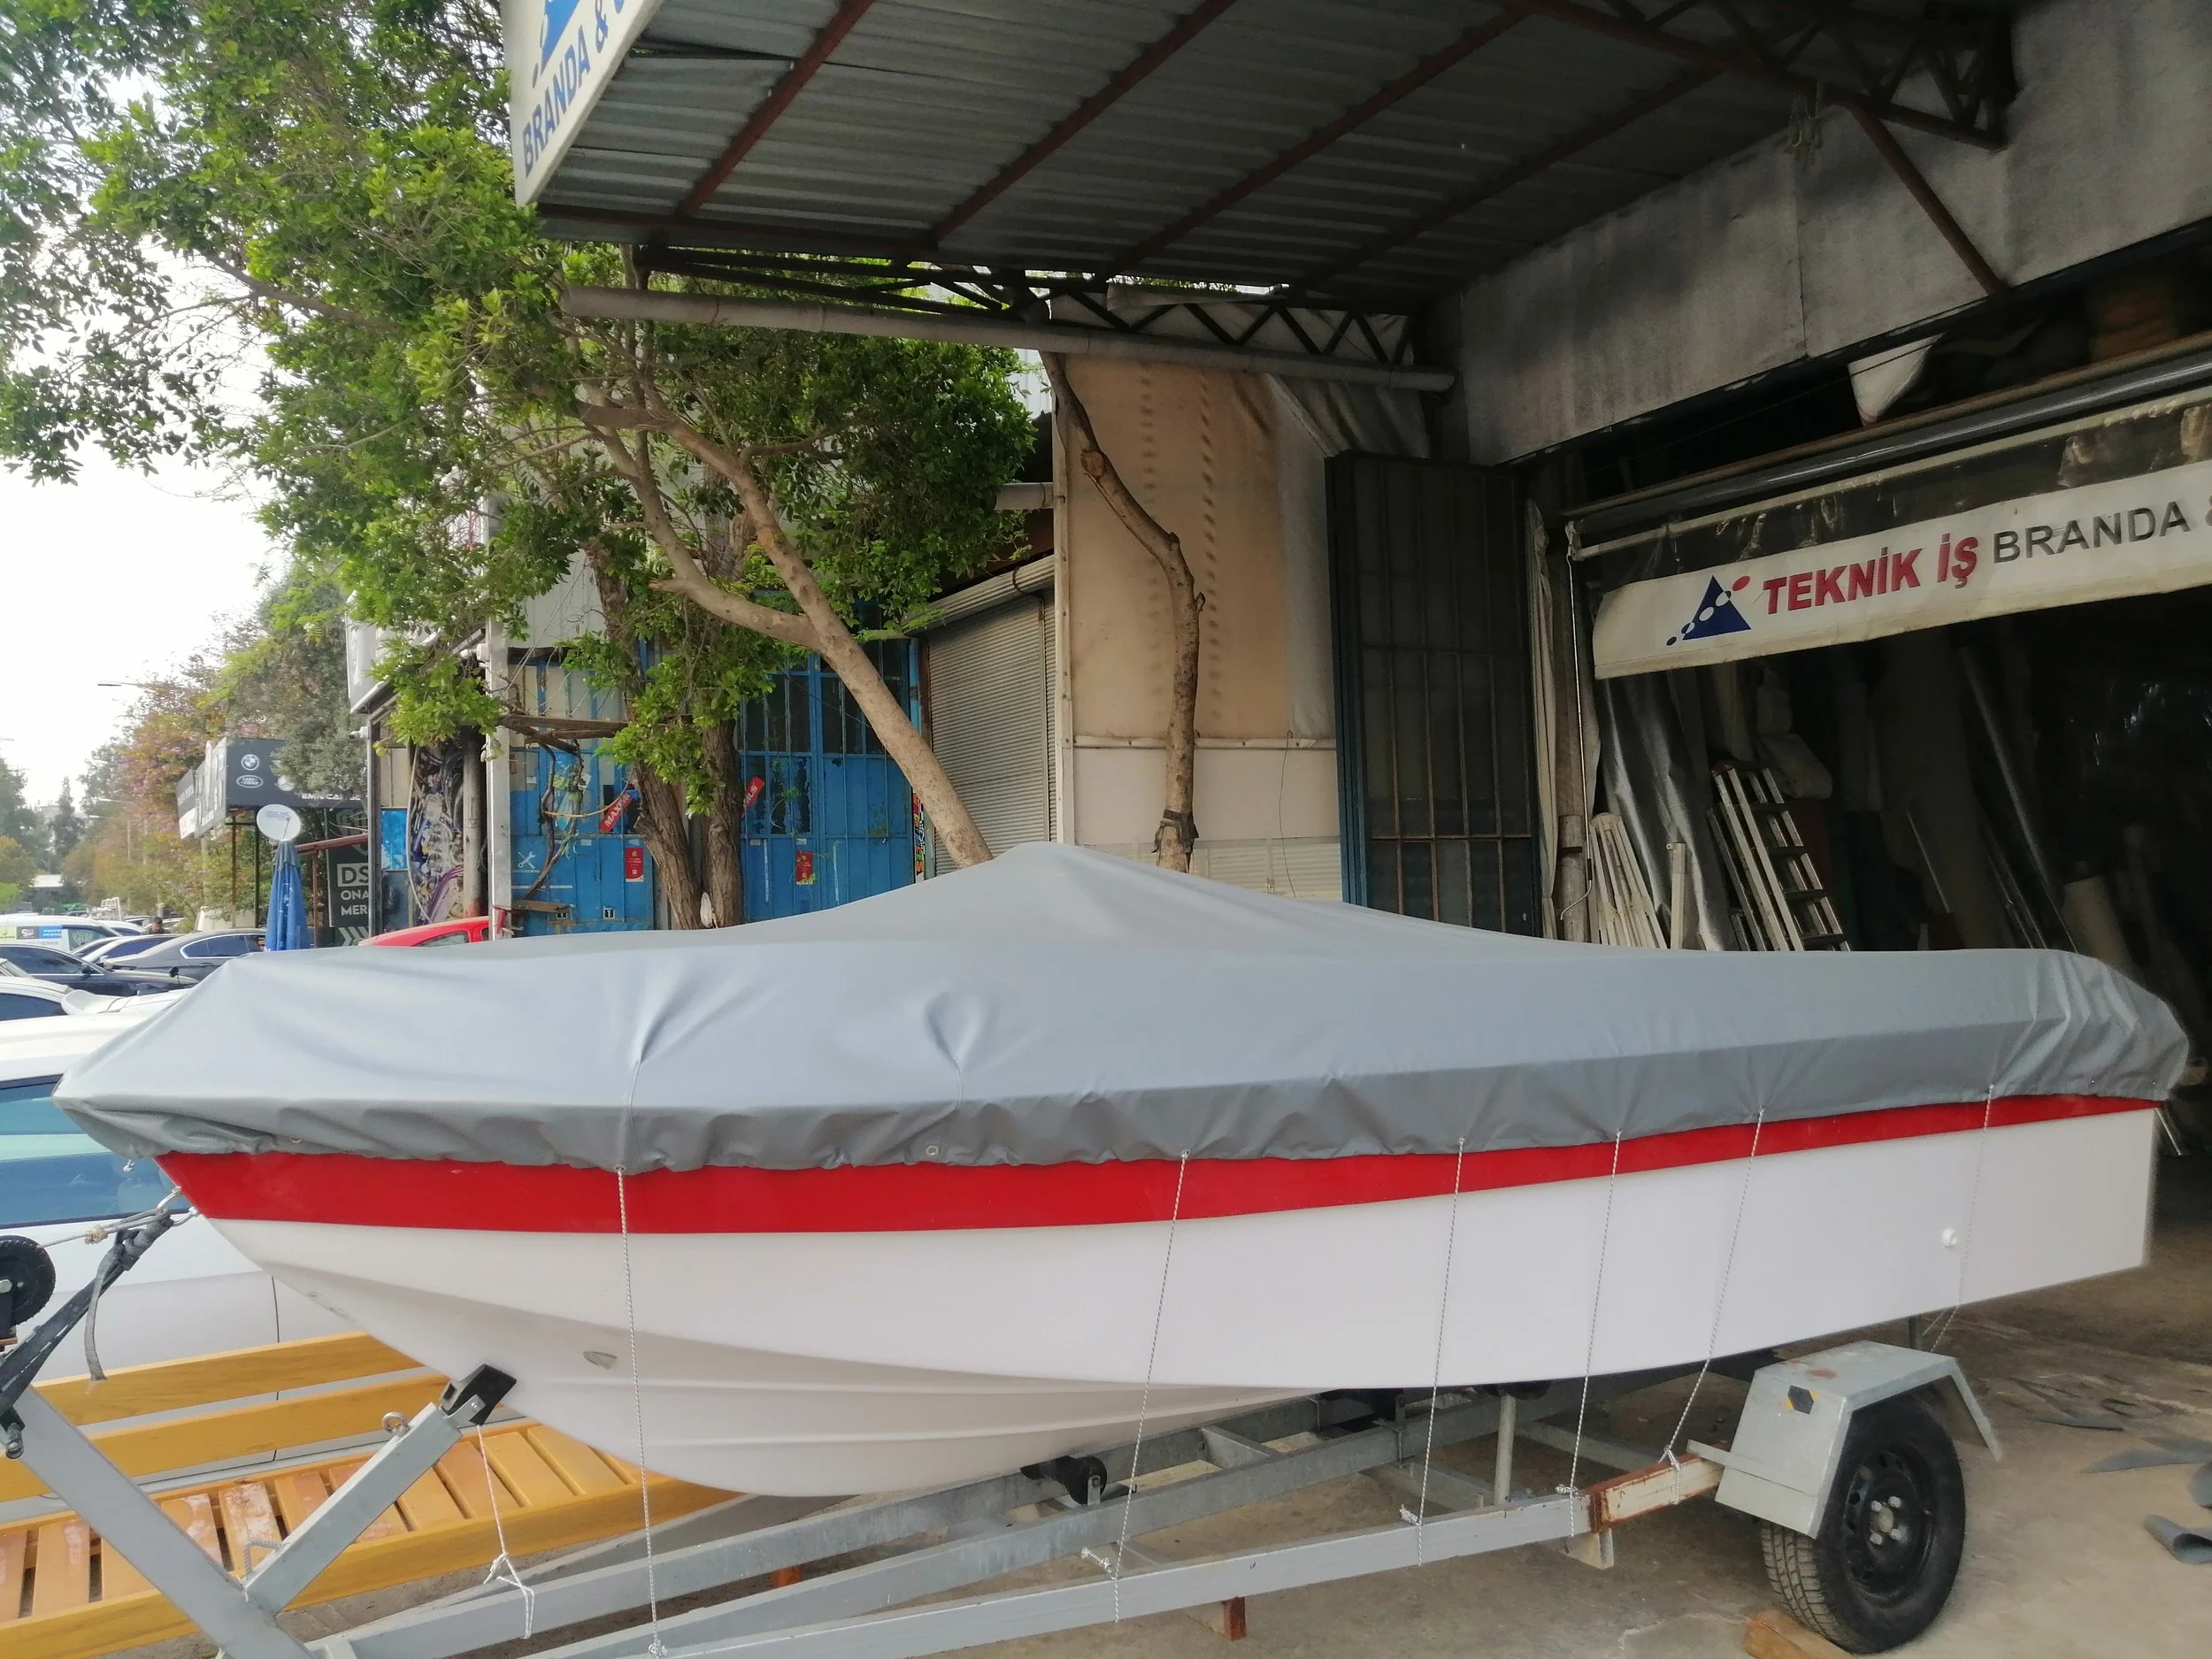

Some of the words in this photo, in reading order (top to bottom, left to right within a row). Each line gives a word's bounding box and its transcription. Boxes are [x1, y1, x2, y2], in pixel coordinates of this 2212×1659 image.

[523, 25, 591, 178] BRANDA
[1763, 546, 1924, 615] TEKNİK
[1936, 533, 1978, 589] İŞ
[1993, 501, 2191, 564] BRANDA
